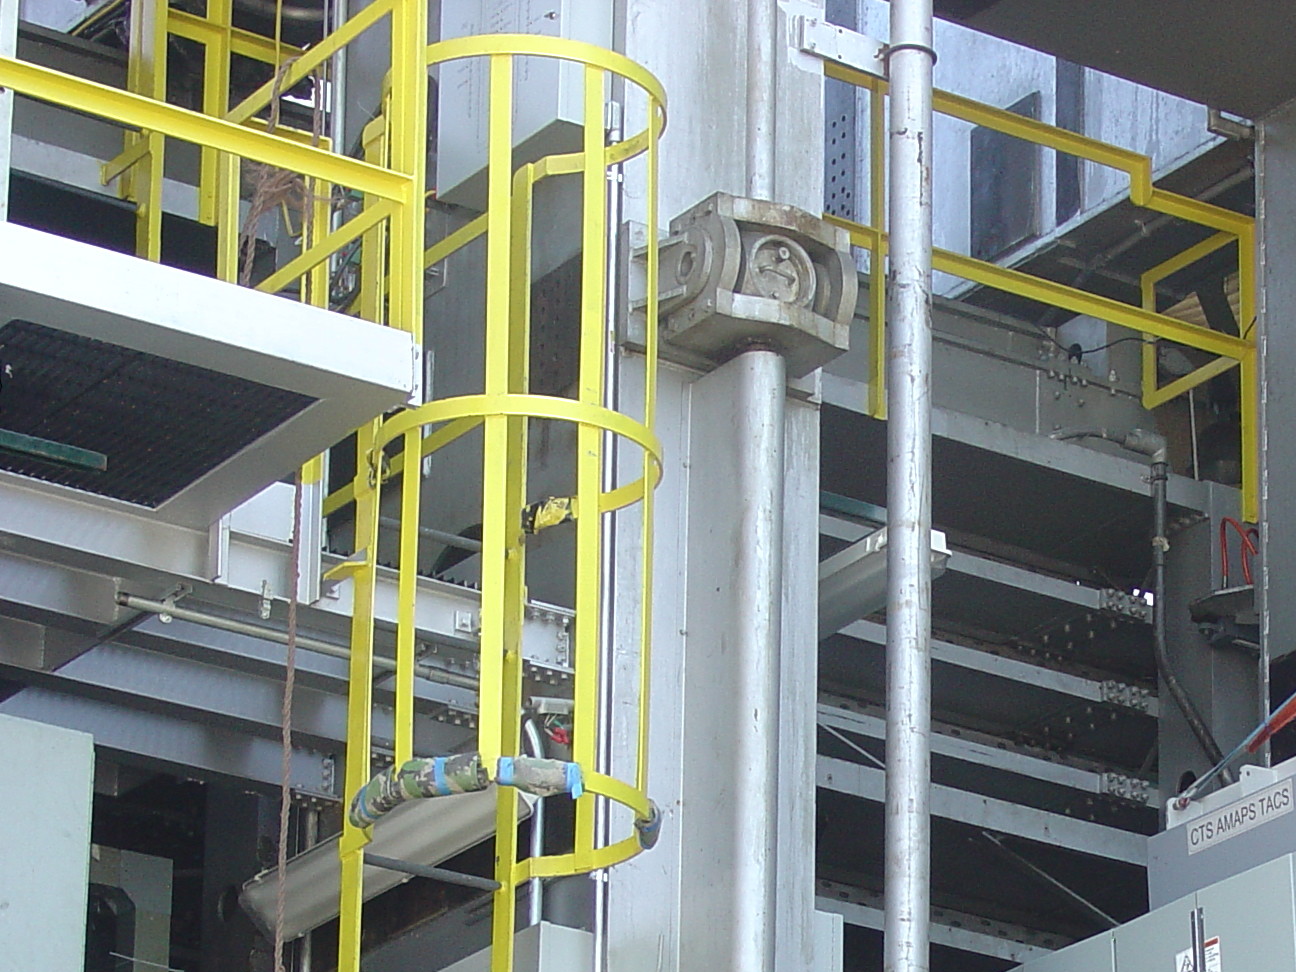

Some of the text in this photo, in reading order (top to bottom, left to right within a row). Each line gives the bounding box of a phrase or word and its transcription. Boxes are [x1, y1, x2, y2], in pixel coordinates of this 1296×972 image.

[1190, 787, 1290, 846] CTS AMAPS TACS
